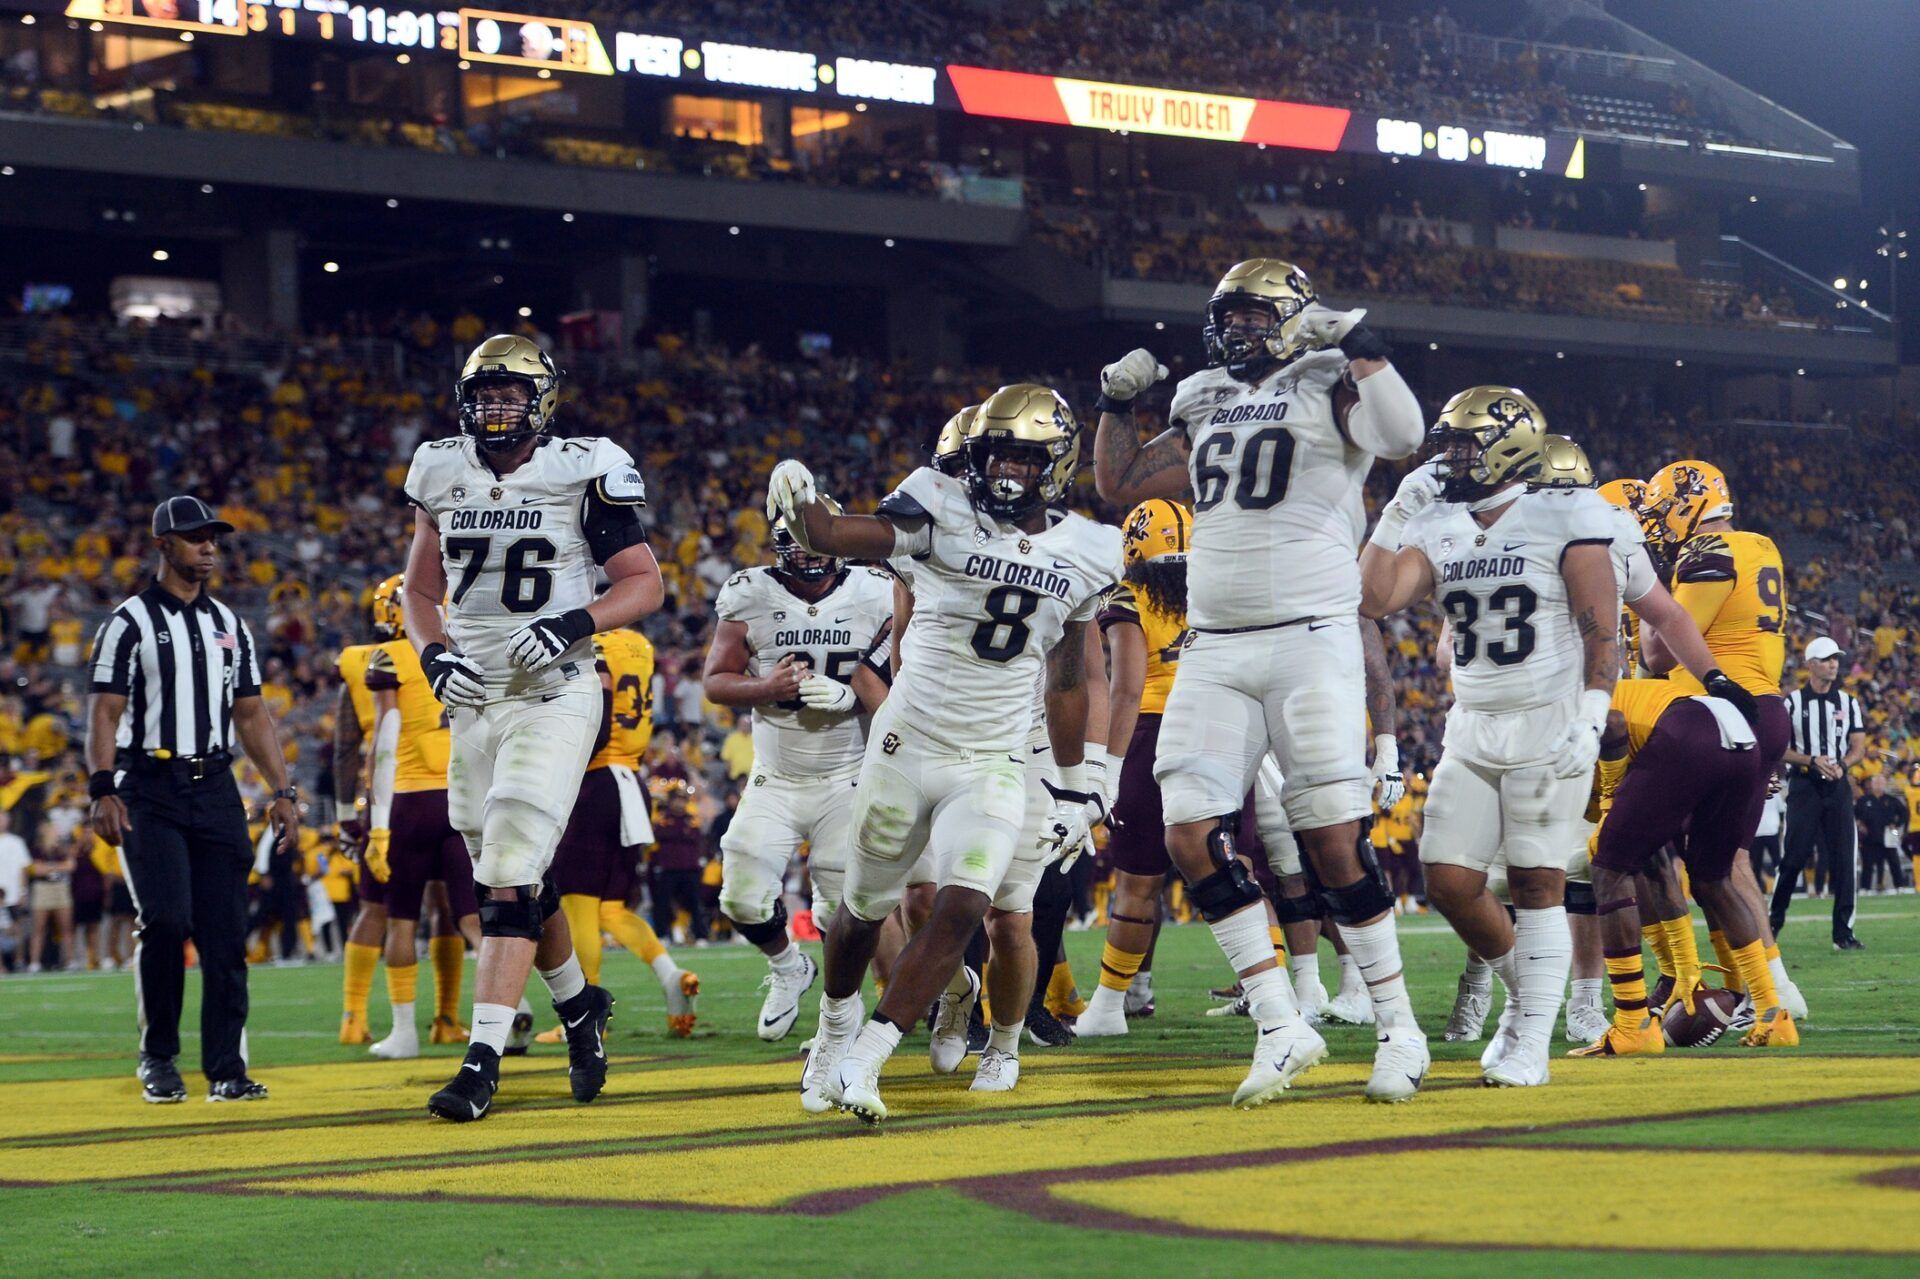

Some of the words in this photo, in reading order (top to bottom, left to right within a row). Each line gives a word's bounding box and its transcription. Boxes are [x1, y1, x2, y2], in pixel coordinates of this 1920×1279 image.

[348, 5, 435, 49] 11:01
[1089, 90, 1154, 125] TRULY
[1164, 98, 1231, 132] NOLEN
[1195, 427, 1296, 513] 60
[451, 510, 542, 530] COLORADO
[446, 537, 556, 614] 76
[964, 554, 1071, 599] COLORADO
[1443, 557, 1525, 584] COLORADO
[775, 629, 851, 646] COLORADO
[970, 584, 1040, 664] 8
[1443, 584, 1538, 667] 33
